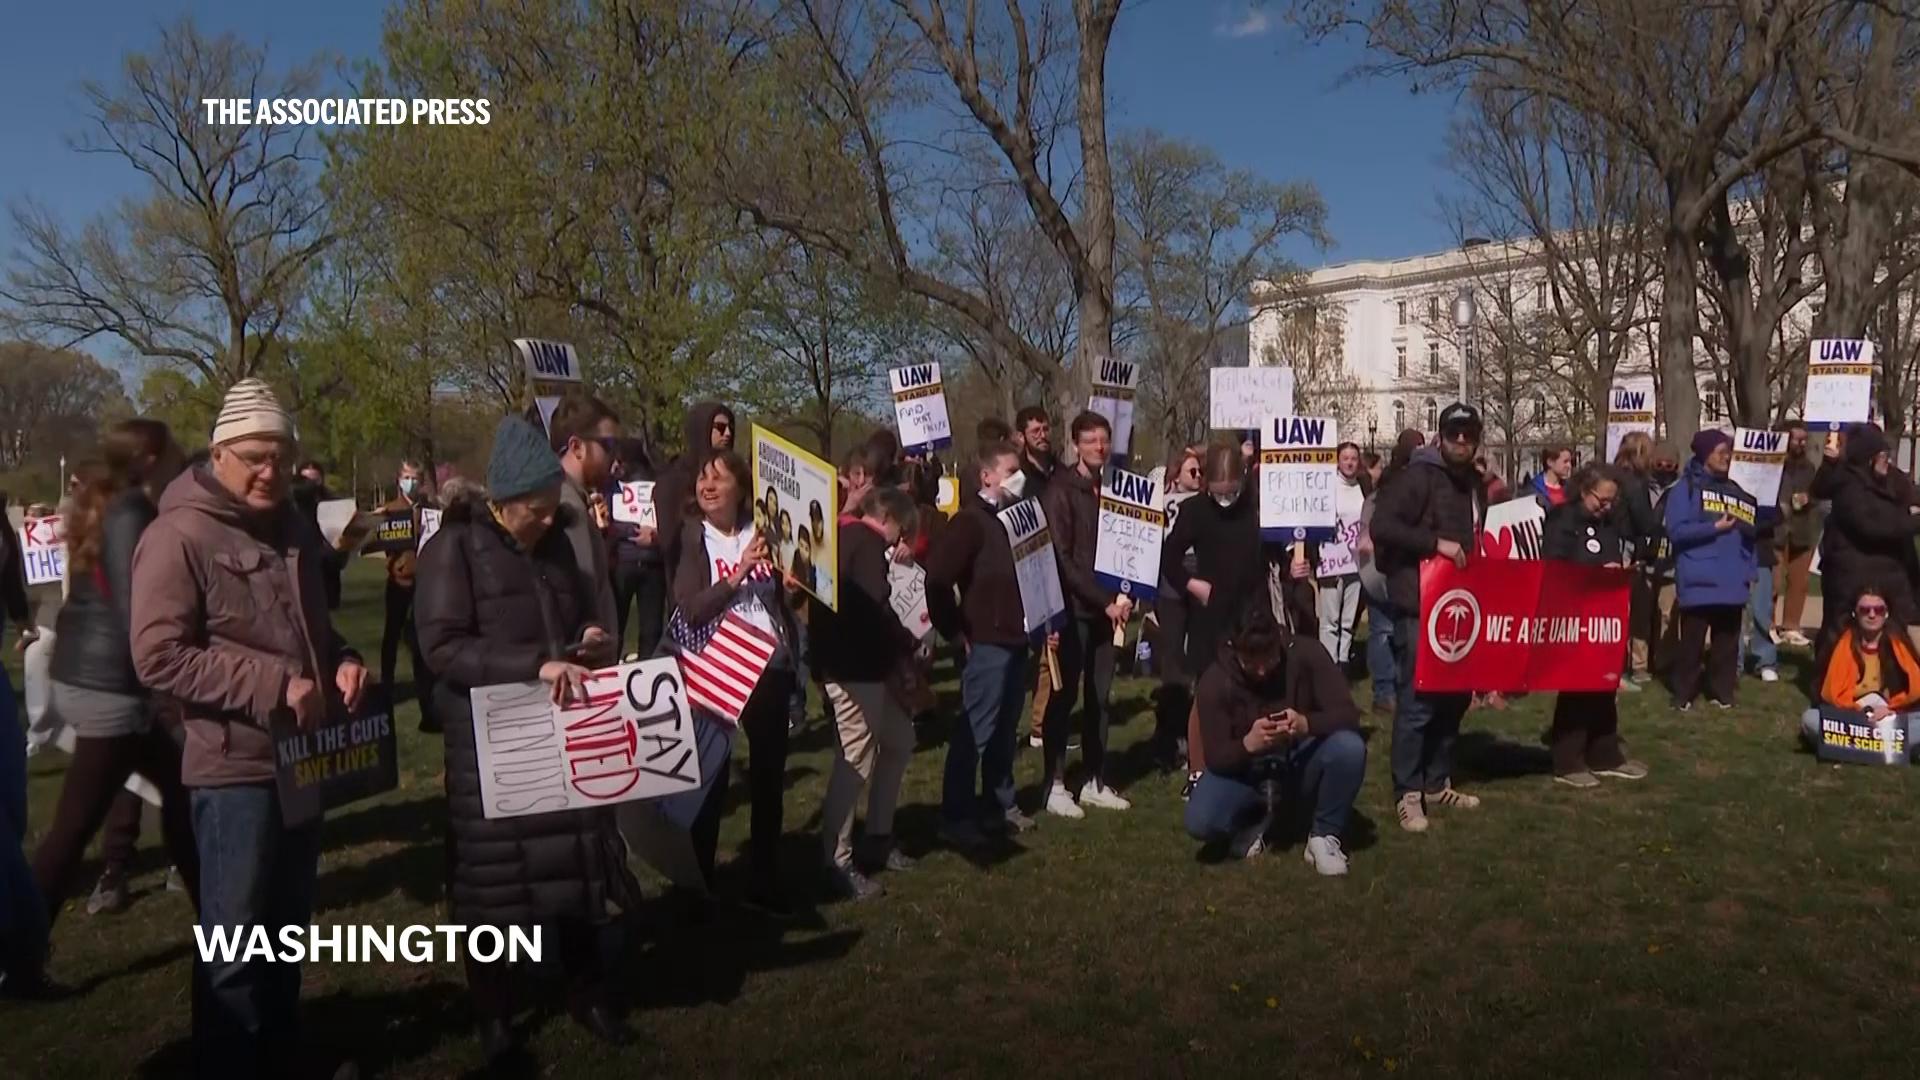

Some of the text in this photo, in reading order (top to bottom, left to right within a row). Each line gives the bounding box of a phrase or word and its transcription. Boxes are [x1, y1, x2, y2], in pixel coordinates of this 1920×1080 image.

[527, 341, 570, 377] UAW
[1820, 341, 1863, 361] UAW
[899, 365, 932, 387] UAW
[1101, 358, 1133, 386] UAW
[1813, 367, 1868, 375] STAND UP
[1615, 391, 1646, 409] UAW
[1274, 417, 1325, 445] UAW
[1744, 431, 1781, 451] UAW
[1265, 453, 1334, 464] STAND UP
[758, 460, 800, 500] DISAPPEARED
[1111, 468, 1155, 506] UAW
[1268, 471, 1332, 491] PROTECT
[1272, 496, 1330, 513] SCIENCE
[1702, 489, 1720, 502] KILL
[1005, 500, 1039, 537] UAW
[1103, 501, 1161, 524] STAND UP
[26, 547, 63, 579] THE
[1486, 615, 1622, 643] WE ARE UAM-UMD
[560, 671, 640, 800] UNITED
[626, 668, 697, 784] STAY
[1823, 719, 1905, 741] KILL THE CTS
[278, 714, 390, 767] KILL THE CUTS
[486, 683, 569, 814] SCIENTISTS
[1824, 733, 1851, 748] SAVE
[295, 744, 379, 788] SAVE LIVES
